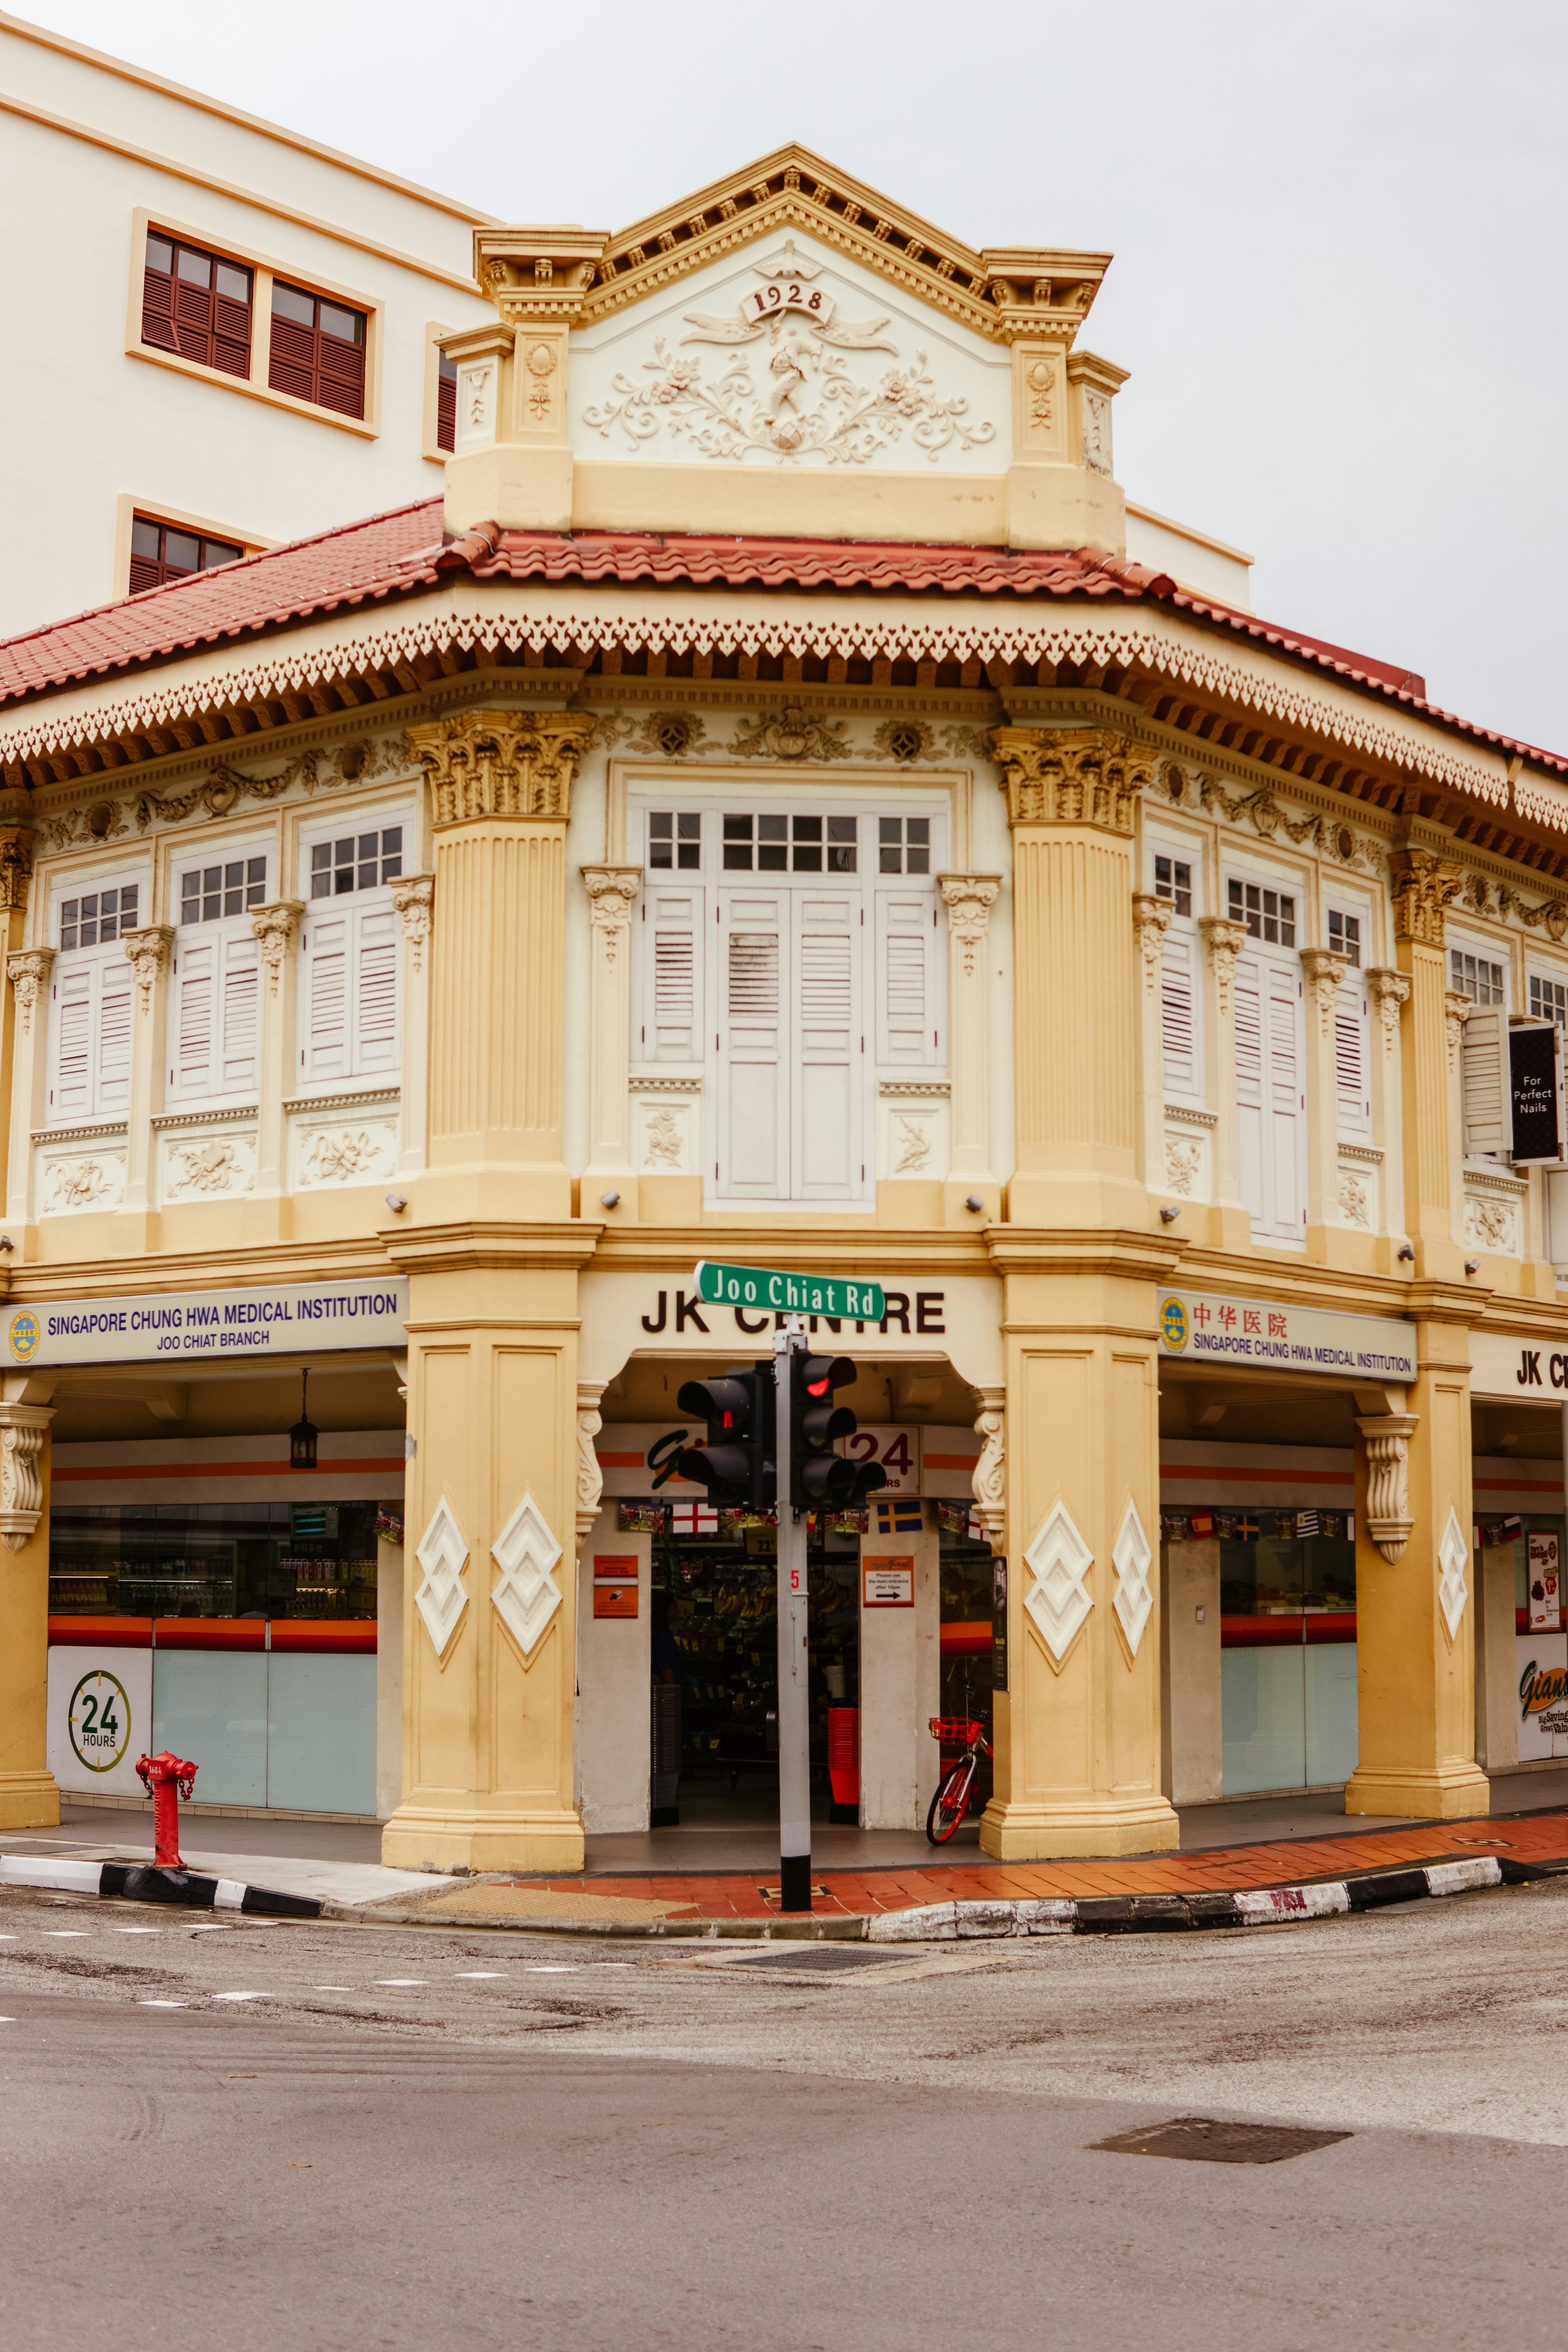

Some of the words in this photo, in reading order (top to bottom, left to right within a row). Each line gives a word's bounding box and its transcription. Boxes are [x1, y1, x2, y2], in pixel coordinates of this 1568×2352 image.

[754, 285, 822, 311] 1928
[1524, 1076, 1541, 1085] For
[1514, 1089, 1552, 1100] Perfect
[1520, 1102, 1547, 1113] Nails
[713, 1269, 757, 1302] Joo
[769, 1276, 835, 1311] Chiat
[847, 1285, 873, 1315] Rd
[48, 1311, 127, 1336] SINGAPORE
[131, 1308, 182, 1331] CHUNG
[187, 1305, 220, 1327] HWA
[224, 1301, 293, 1324] MEDICAL
[297, 1293, 397, 1320] INSTITUTION
[641, 1291, 710, 1333] JK
[1194, 1303, 1287, 1339] 中华医院
[157, 1335, 181, 1350] JOO
[183, 1333, 217, 1349] CHIAT
[220, 1330, 270, 1347] BRANCH
[1194, 1333, 1252, 1355] SINGAPORE
[1255, 1340, 1289, 1359] CHUNG
[1291, 1345, 1313, 1361] HWA
[1314, 1348, 1356, 1366] MEDICAL
[1357, 1353, 1411, 1372] INSTITUTION
[1517, 1350, 1543, 1385] JK
[850, 1433, 914, 1476] 24
[791, 1570, 799, 1589] 5
[82, 1694, 118, 1735] 24
[1553, 1722, 1568, 1733] Valu
[83, 1734, 116, 1747] HOURS
[149, 1765, 162, 1774] 1684
